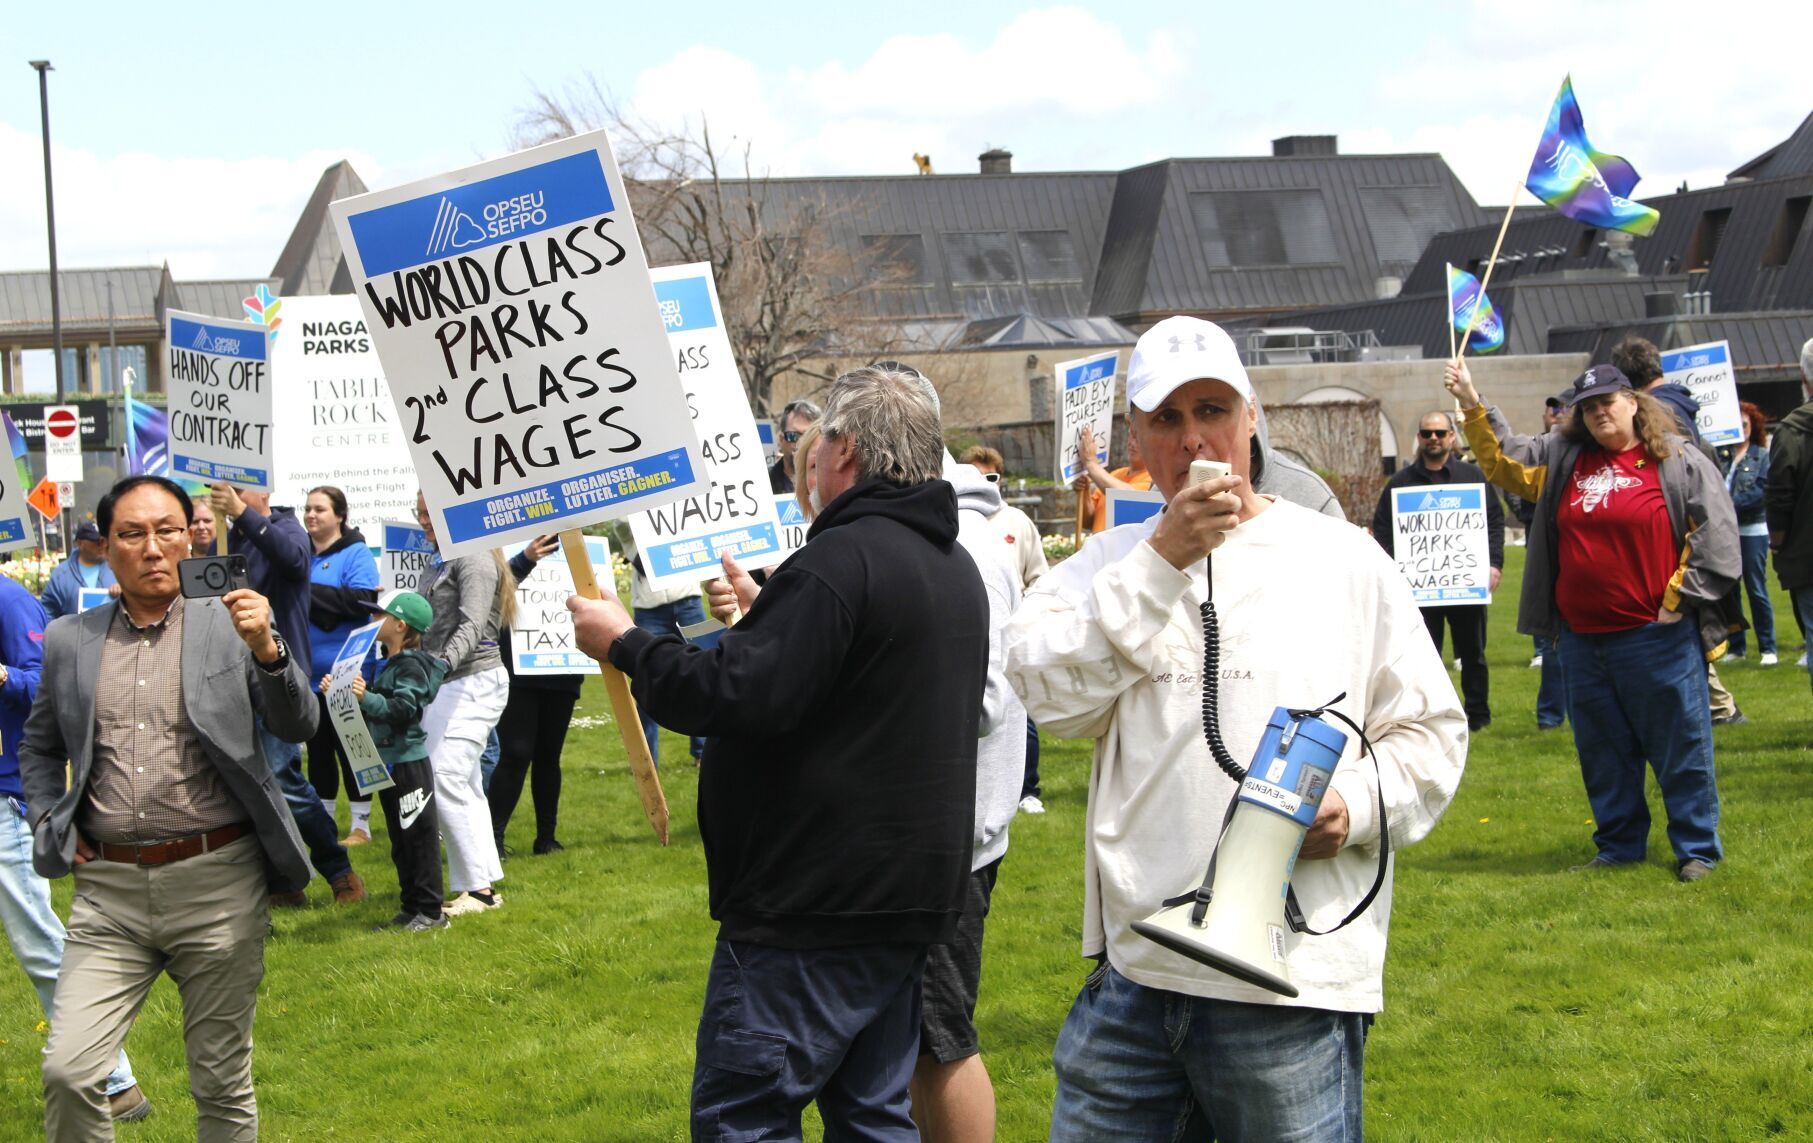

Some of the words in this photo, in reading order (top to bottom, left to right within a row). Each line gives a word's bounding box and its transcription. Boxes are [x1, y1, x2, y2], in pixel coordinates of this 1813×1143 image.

[483, 190, 544, 222] OPSEU
[487, 208, 548, 239] SEFPO
[365, 255, 490, 329] WORLD
[494, 217, 626, 297] CLASS
[660, 299, 680, 315] SEU
[303, 320, 368, 337] NIAGA
[435, 291, 588, 379] PARKS
[304, 339, 369, 355] PARKS
[678, 345, 709, 373] ASS
[171, 348, 221, 387] HANDS
[229, 361, 265, 393] OFF
[1685, 370, 1727, 387] Cannot
[307, 377, 388, 400] TABLE
[404, 384, 447, 444] 2nd
[465, 347, 637, 424] CLASS
[1066, 386, 1087, 411] PAID
[1092, 378, 1110, 400] BY
[191, 390, 231, 414] OUR
[312, 402, 387, 426] ROCK
[1066, 396, 1110, 429] TOURISM
[171, 410, 269, 455] CONTRACT
[312, 433, 390, 447] CENTRE
[432, 405, 642, 496] WAGES
[702, 432, 741, 466] ASS
[289, 472, 330, 480] Journey
[334, 468, 370, 479] Behind
[373, 467, 389, 476] the
[393, 465, 416, 474] Falls
[345, 485, 373, 493] Takes
[376, 482, 406, 494] Flight
[483, 510, 526, 530] FIGHT.
[525, 501, 558, 519] WIN.
[565, 487, 618, 510] LUTTER.
[618, 470, 676, 496] GAGNER.
[487, 488, 555, 516] ORGANIZE.
[561, 466, 640, 497] ORGANISER.
[349, 501, 370, 510] ouse
[647, 480, 758, 536] WAGES
[1397, 511, 1443, 534] WORLD
[1445, 511, 1485, 531] CLASS
[1410, 534, 1467, 557] PARKS
[1416, 554, 1478, 573] CLASS
[1406, 573, 1476, 589] WAGES
[517, 588, 573, 605] TOURI
[541, 609, 568, 626] NO
[515, 629, 570, 651] TAX
[1013, 655, 1123, 700] ERIC
[1221, 669, 1255, 680] U.S.A.
[399, 787, 424, 815] NIKE
[1280, 800, 1296, 813] NPC
